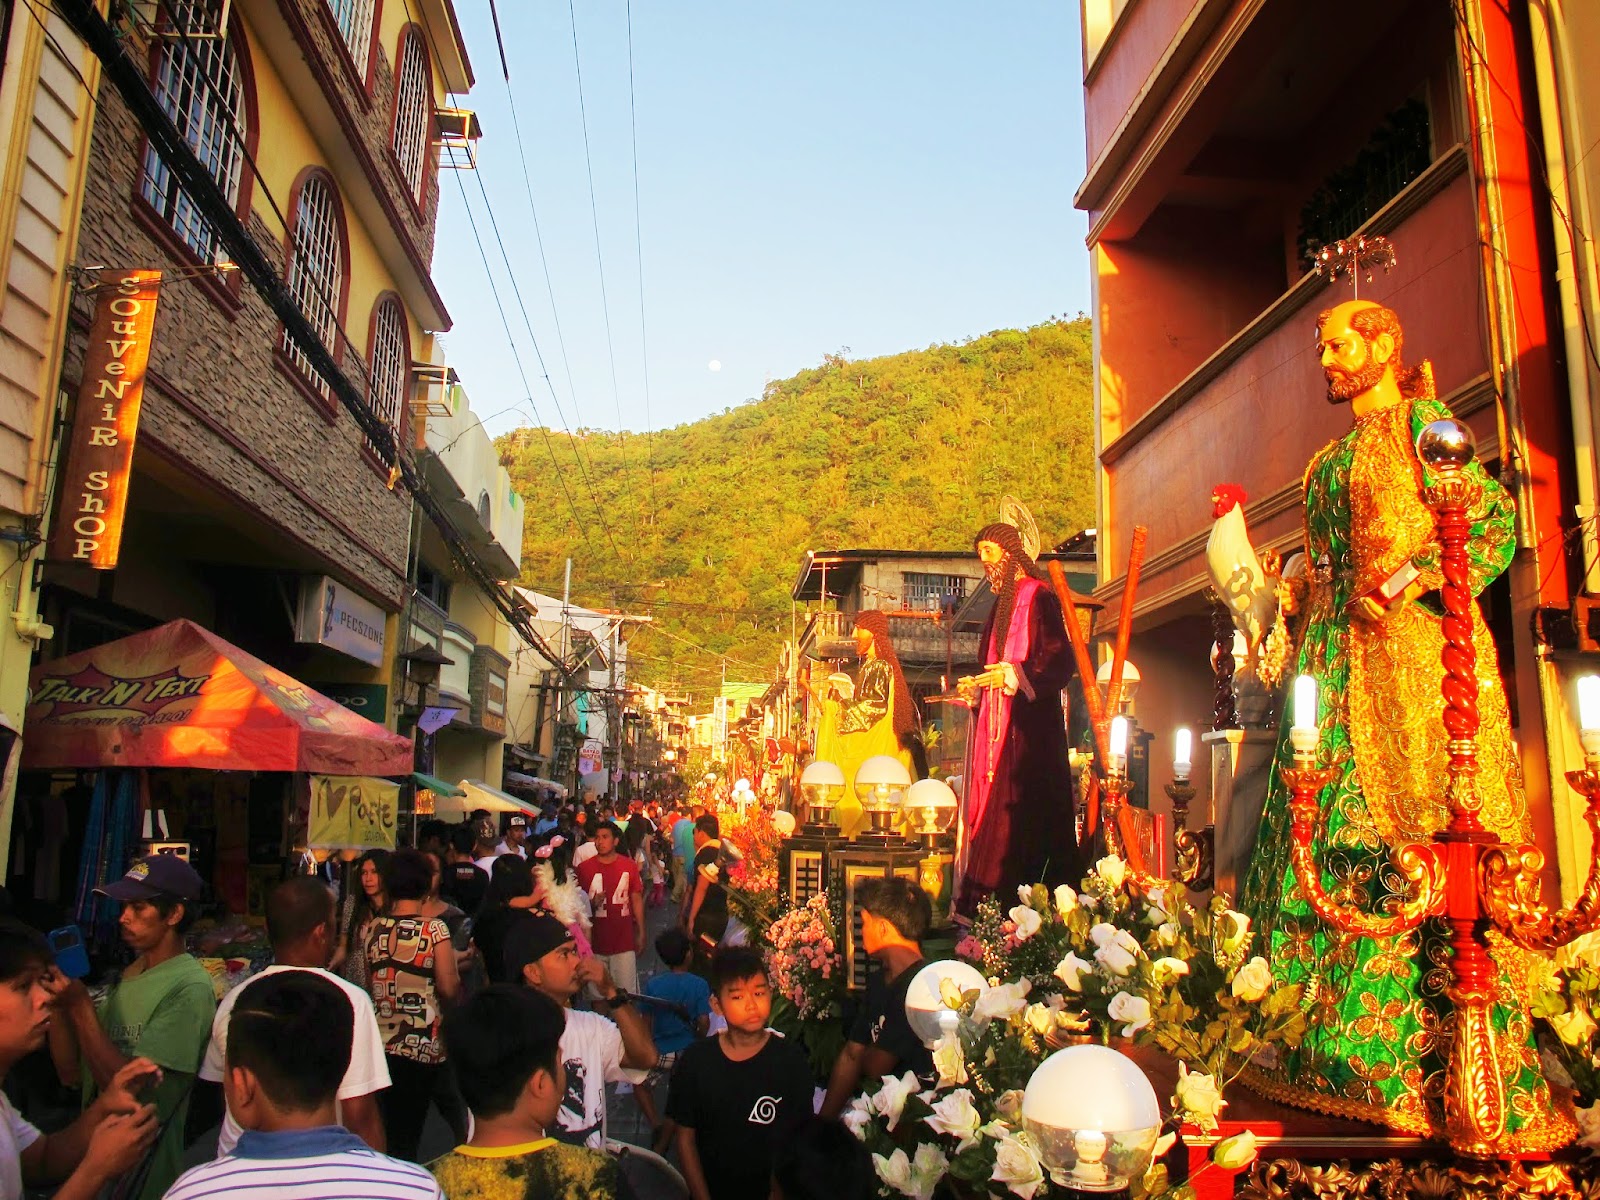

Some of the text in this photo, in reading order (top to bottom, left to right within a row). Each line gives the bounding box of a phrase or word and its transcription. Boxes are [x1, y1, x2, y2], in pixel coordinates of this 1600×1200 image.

[31, 677, 99, 704] TALK
[144, 674, 211, 703] TEXT
[588, 871, 630, 918] 44
